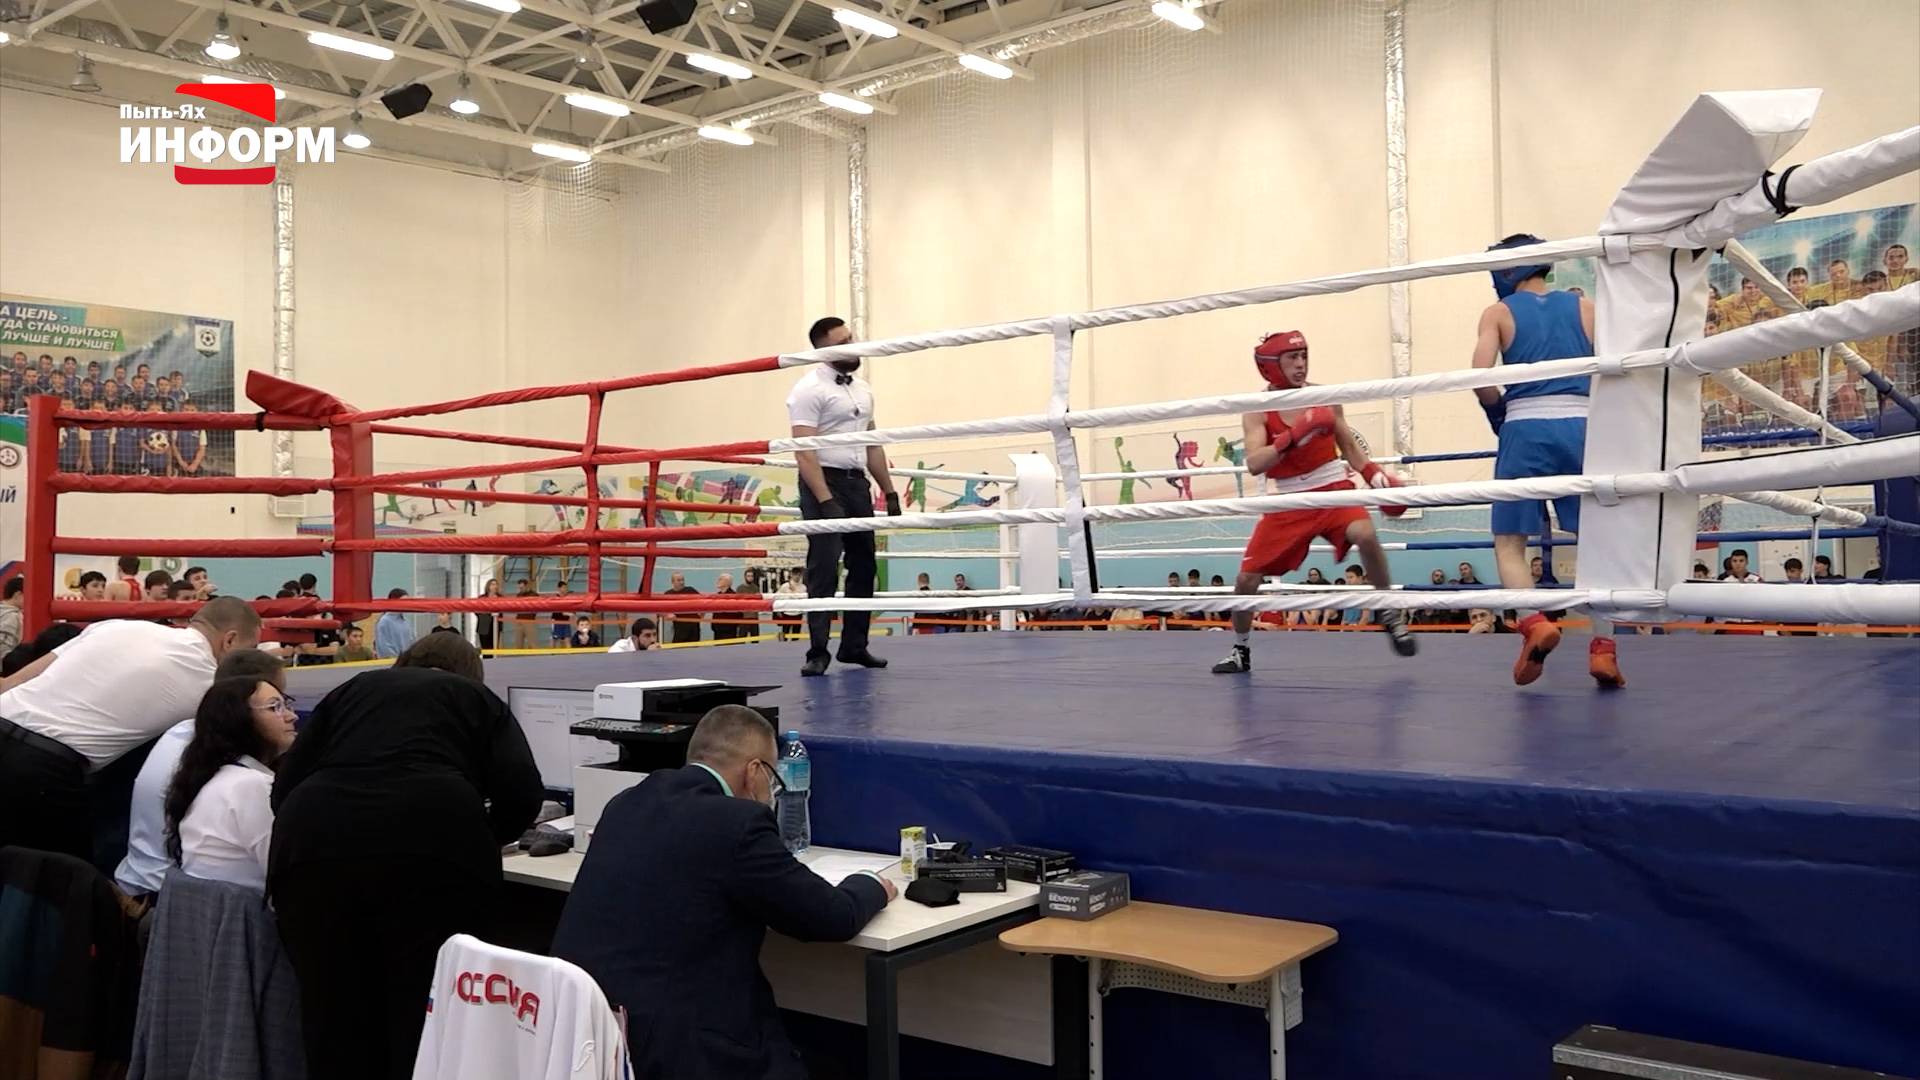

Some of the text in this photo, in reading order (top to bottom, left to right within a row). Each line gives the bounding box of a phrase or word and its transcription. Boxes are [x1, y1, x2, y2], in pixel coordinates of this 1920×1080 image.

[15, 307, 58, 321] ЦЕЛЬ
[27, 321, 119, 339] СТАНОВИТЬСЯ
[2, 331, 115, 351] ЛУЧШЕ И ЛУЧШЕ!
